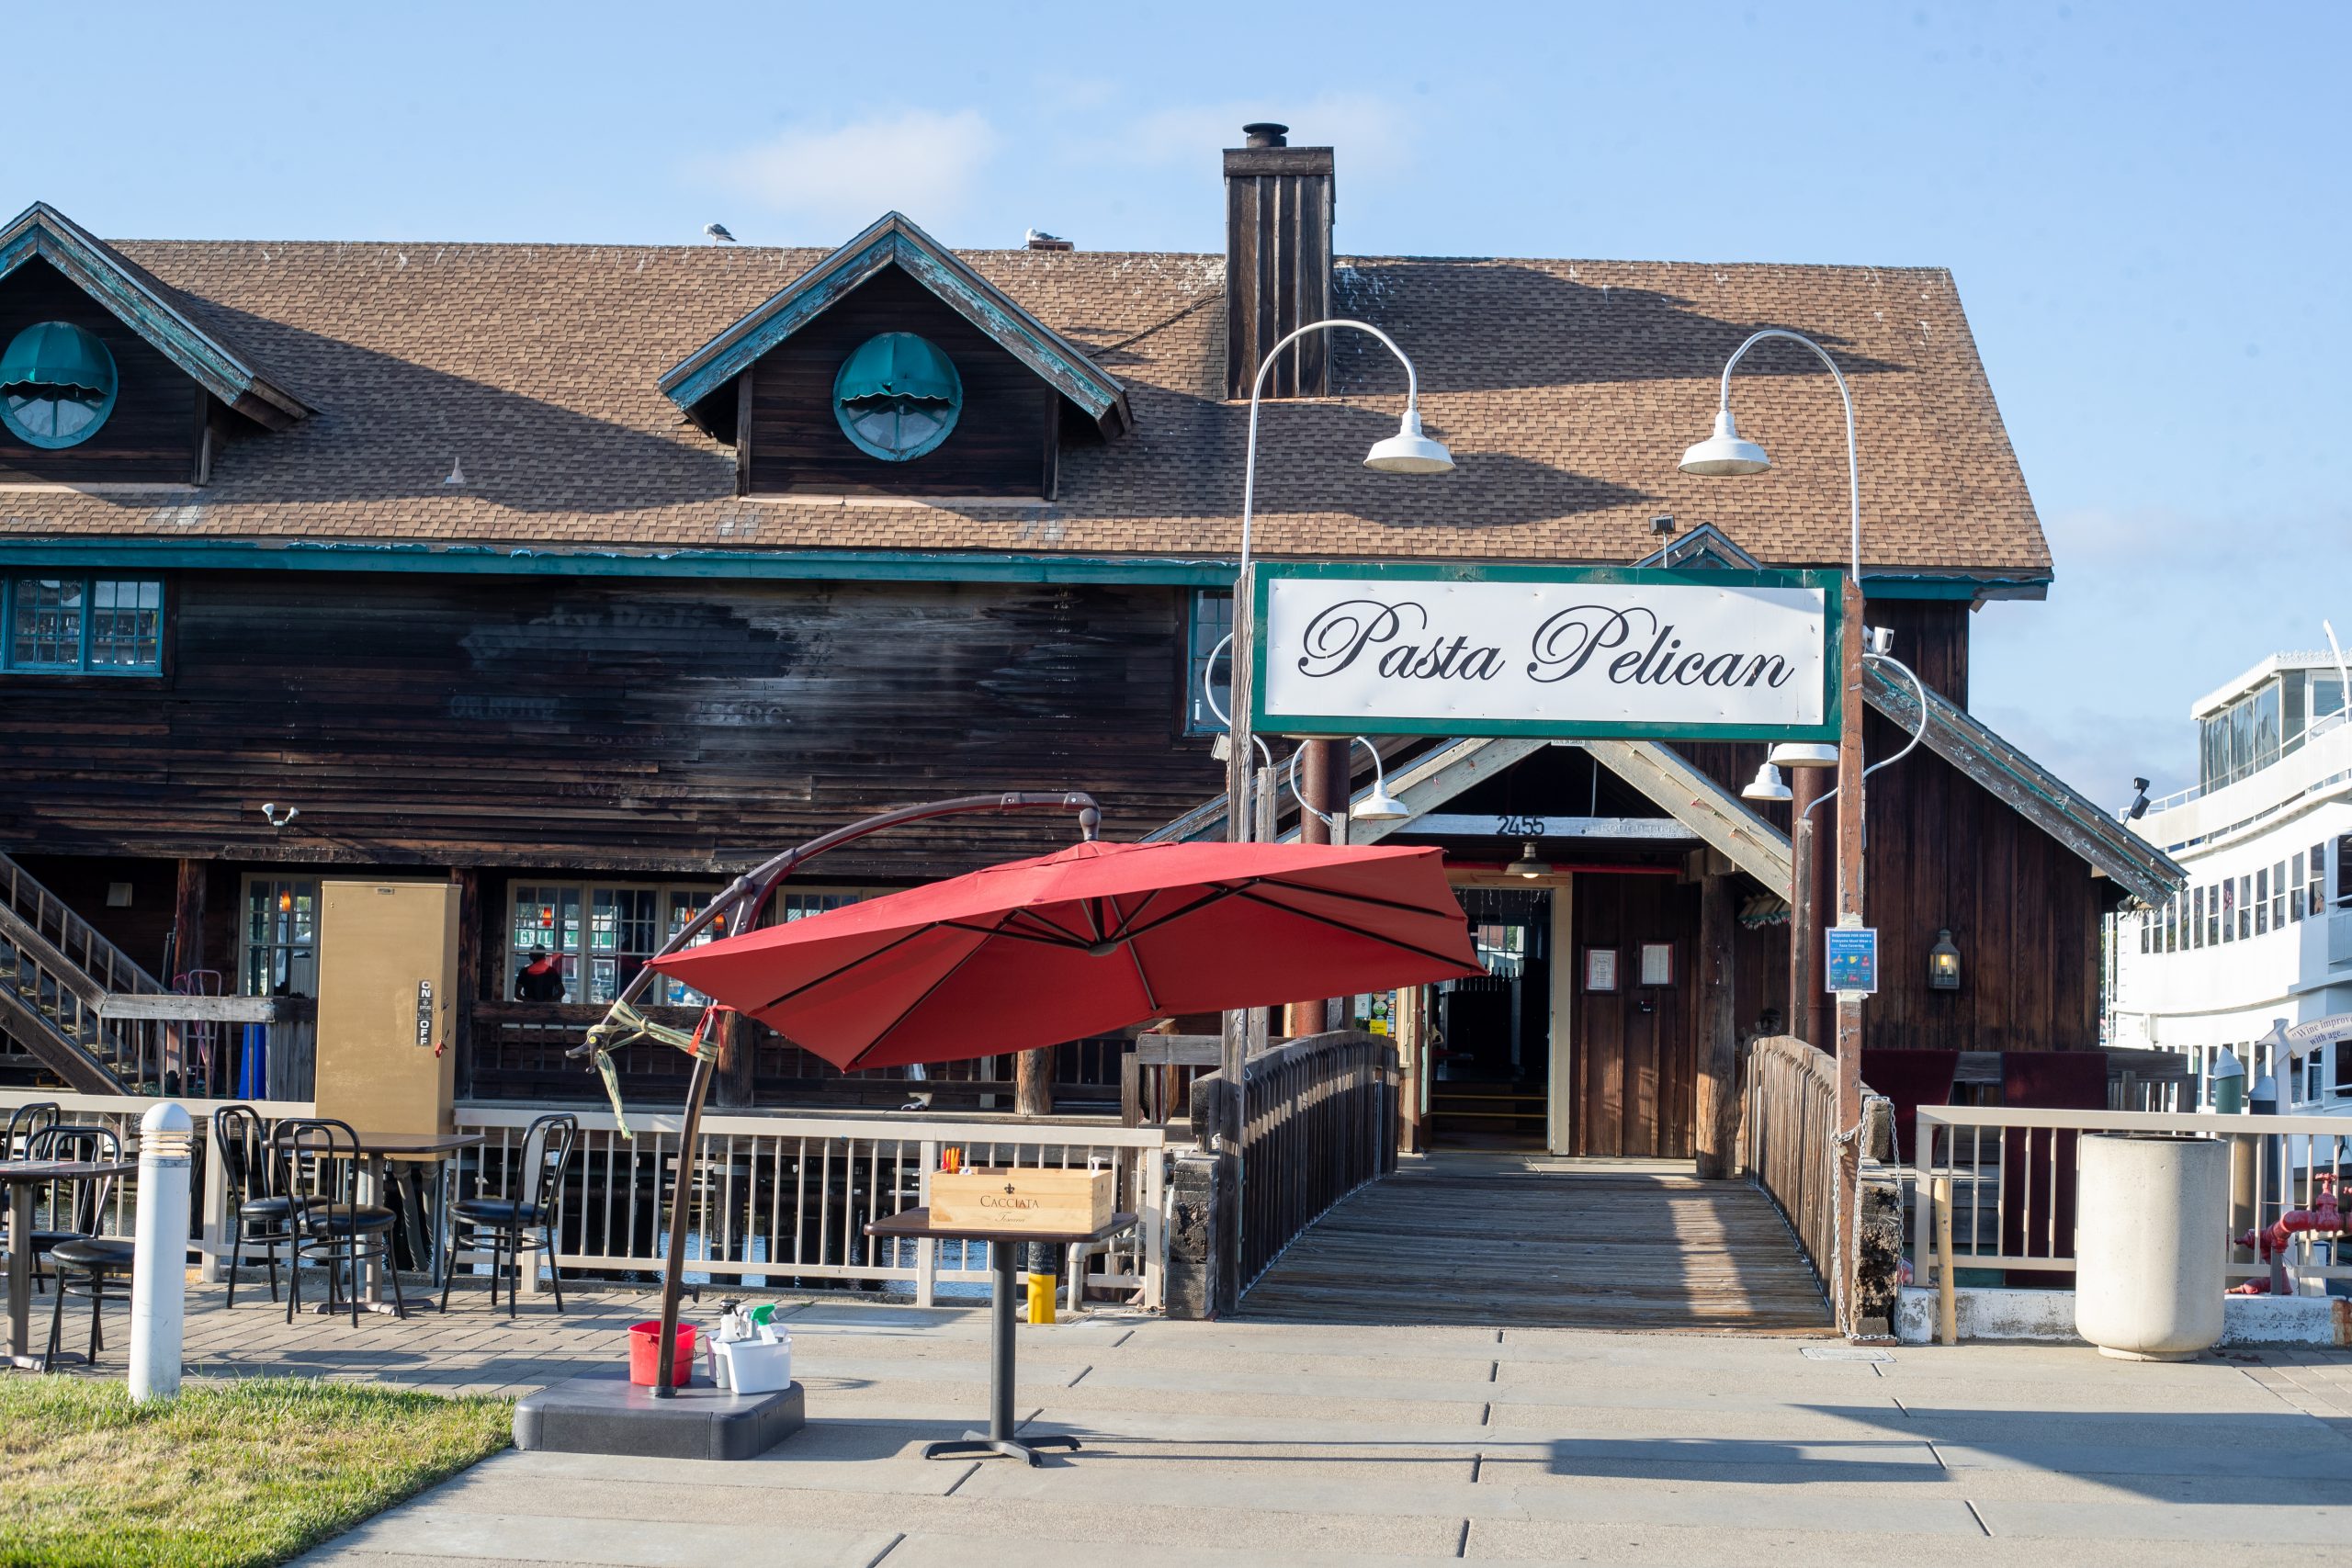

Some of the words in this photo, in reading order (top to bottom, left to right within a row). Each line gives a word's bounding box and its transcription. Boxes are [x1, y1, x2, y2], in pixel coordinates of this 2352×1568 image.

[1297, 599, 1506, 681] Pasta
[1526, 604, 1794, 689] Pelican
[1496, 816, 1545, 835] 2455
[422, 981, 431, 998] ON
[420, 1021, 430, 1044] OFF
[2310, 1032, 2327, 1045] with
[2328, 1030, 2347, 1040] age...
